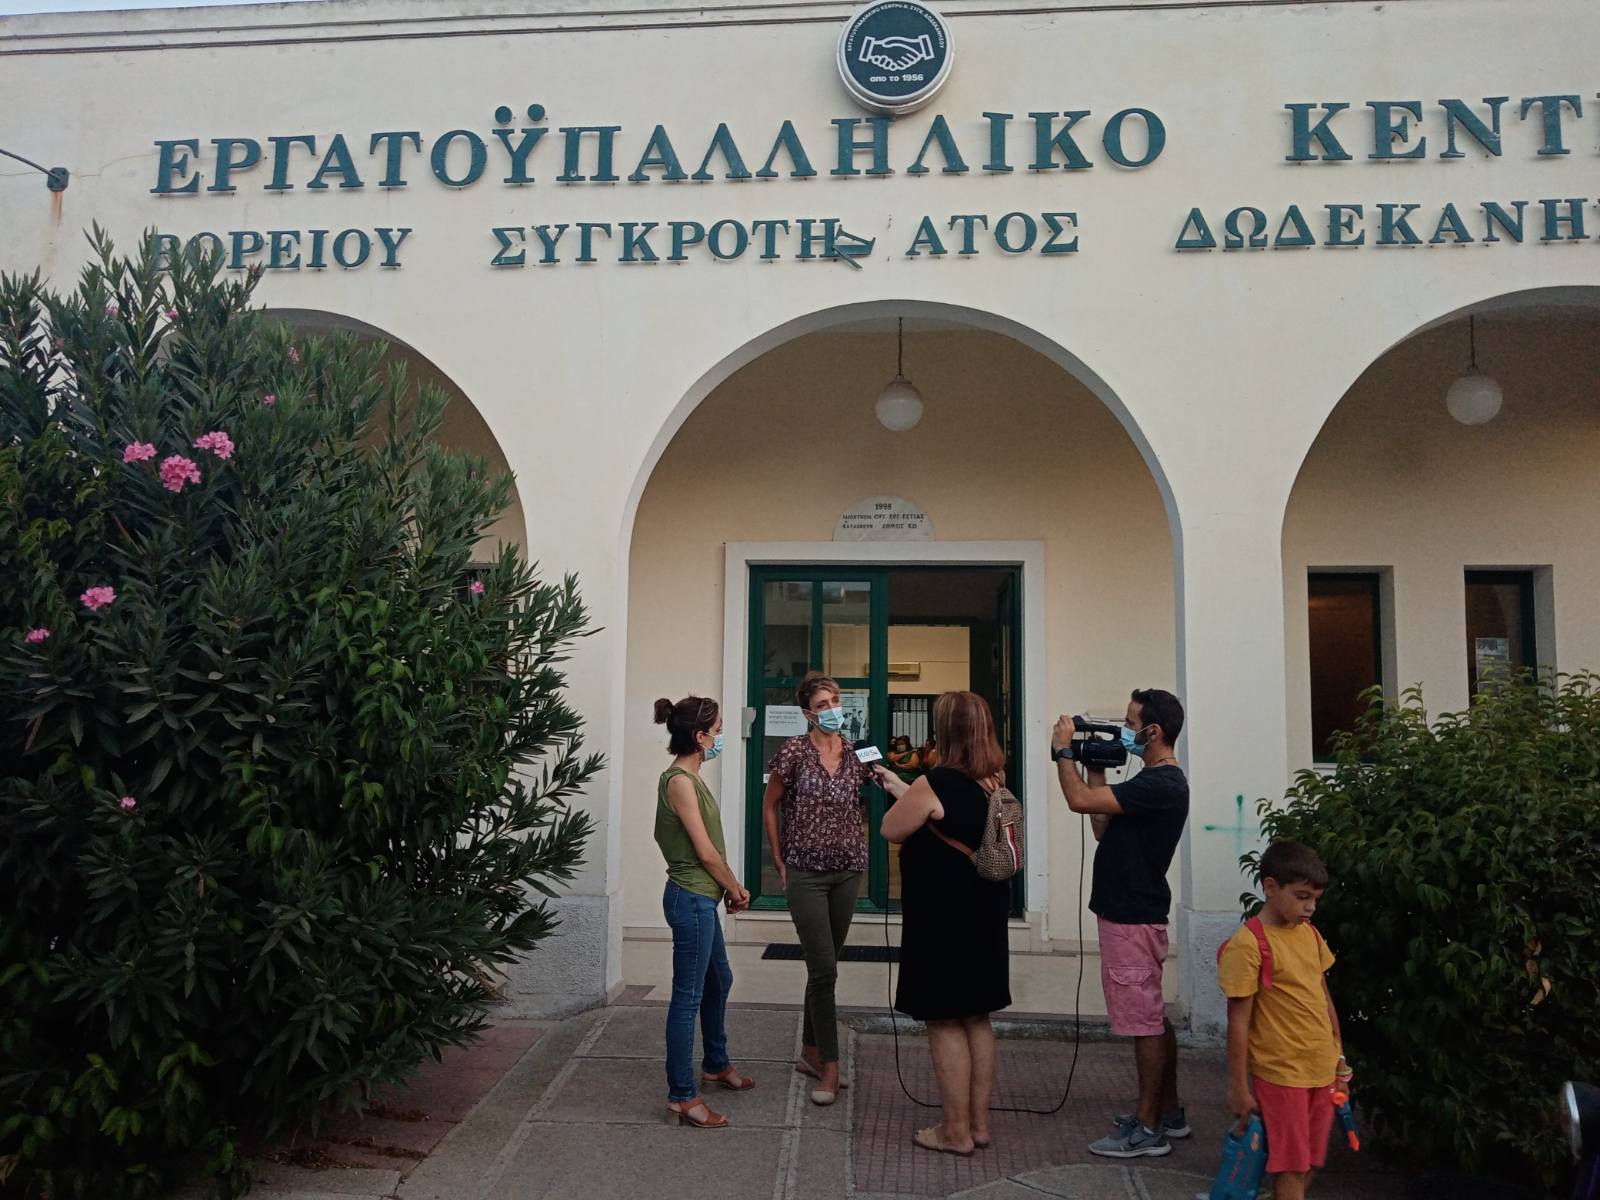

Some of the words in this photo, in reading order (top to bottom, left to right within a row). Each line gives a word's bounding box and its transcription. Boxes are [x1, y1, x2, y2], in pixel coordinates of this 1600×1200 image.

[902, 73, 924, 82] 1956
[150, 104, 1166, 194] ΕΡΓΑΤΟΫΠΑΛΛΗΛΙΚΟ
[1285, 93, 1600, 161] ΚΕΝΤ
[1175, 198, 1600, 249] ΔΩΔΕΚΑΝΗ
